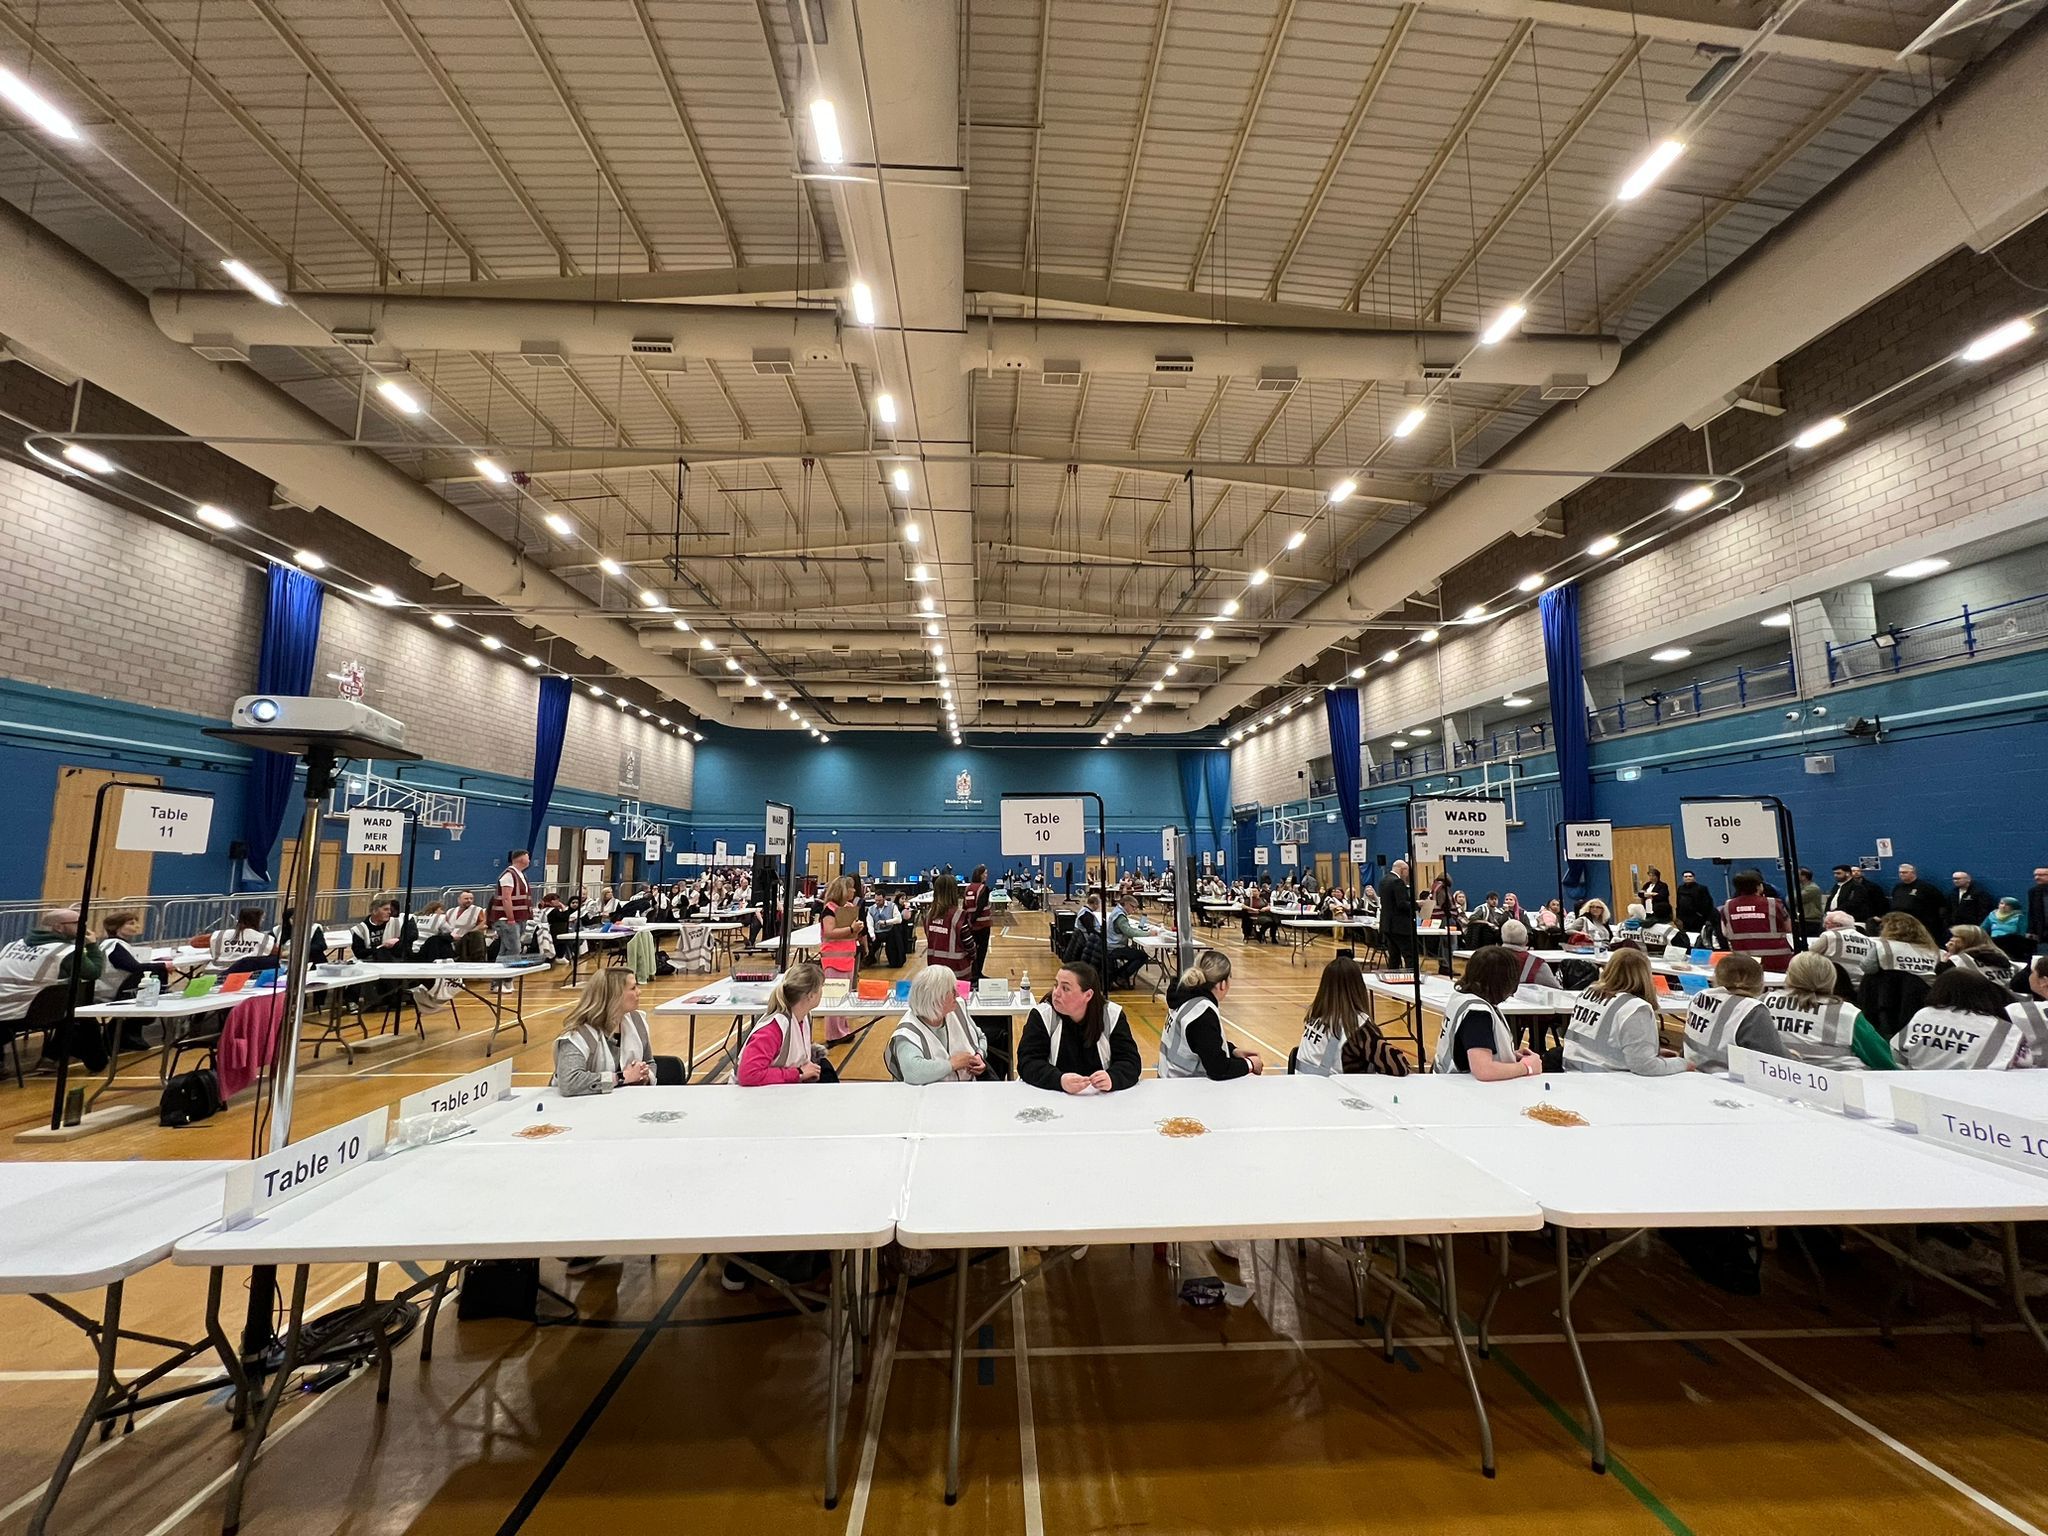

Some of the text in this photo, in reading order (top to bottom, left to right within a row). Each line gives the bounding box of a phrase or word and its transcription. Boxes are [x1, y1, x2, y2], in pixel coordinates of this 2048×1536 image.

[151, 806, 189, 821] Table
[1024, 813, 1060, 824] Table
[1445, 811, 1487, 822] WARD
[363, 817, 392, 827] WARD
[1705, 816, 1742, 828] Table
[160, 826, 174, 838] 11
[365, 832, 388, 841] MEIR
[1035, 830, 1051, 841] 10
[1448, 829, 1486, 837] BASFORD
[1721, 833, 1730, 844] 9
[363, 843, 388, 851] PARK
[1445, 846, 1490, 854] HARTSHILL
[223, 939, 259, 948] COUNT
[223, 946, 255, 954] STAFF
[1896, 955, 1935, 966] COUNT
[1771, 1015, 1815, 1035] TAFF
[1912, 1023, 1980, 1044] COUNT
[1909, 1034, 1970, 1055] STAFF
[1759, 1059, 1829, 1092] Table 10
[431, 1081, 489, 1112] Table 10
[1941, 1113, 2012, 1148] Table
[264, 1136, 360, 1198] Table 10
